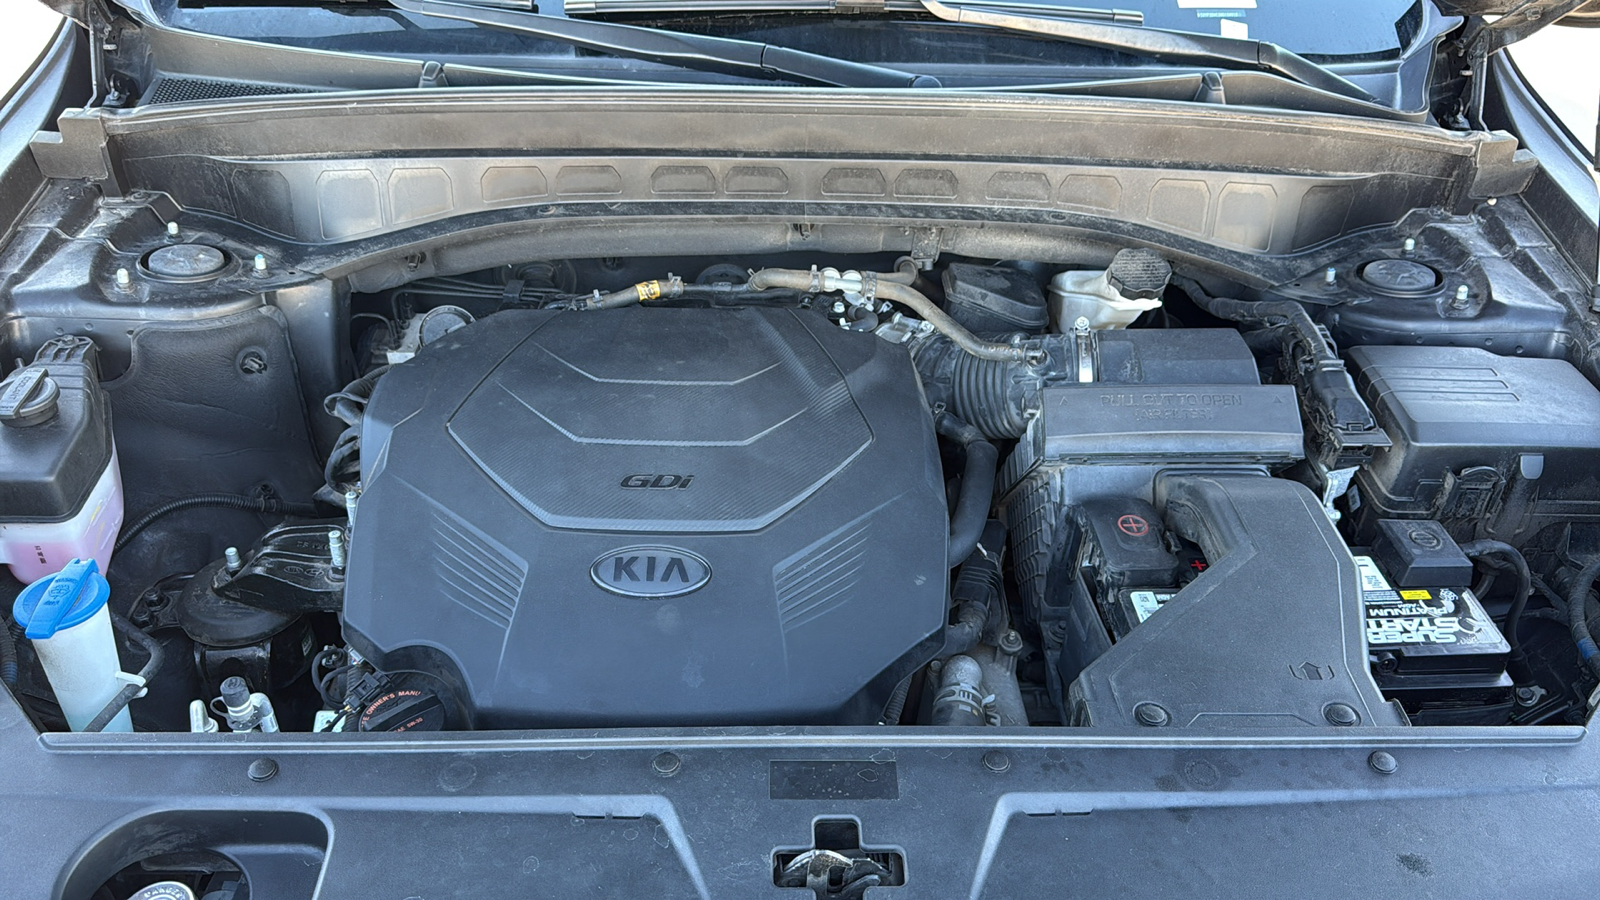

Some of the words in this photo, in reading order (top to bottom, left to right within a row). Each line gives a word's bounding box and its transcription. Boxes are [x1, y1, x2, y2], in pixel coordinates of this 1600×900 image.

[1100, 393, 1139, 406] PULL
[1143, 393, 1173, 406] OUT
[1176, 393, 1197, 406] TO
[1201, 393, 1243, 406] OPEN
[620, 474, 694, 490] GDi
[613, 556, 690, 583] KIA
[1369, 606, 1448, 616] PLATINUM
[1366, 617, 1460, 632] START
[1367, 630, 1457, 644] SUPER
[366, 693, 395, 715] OWNER'S
